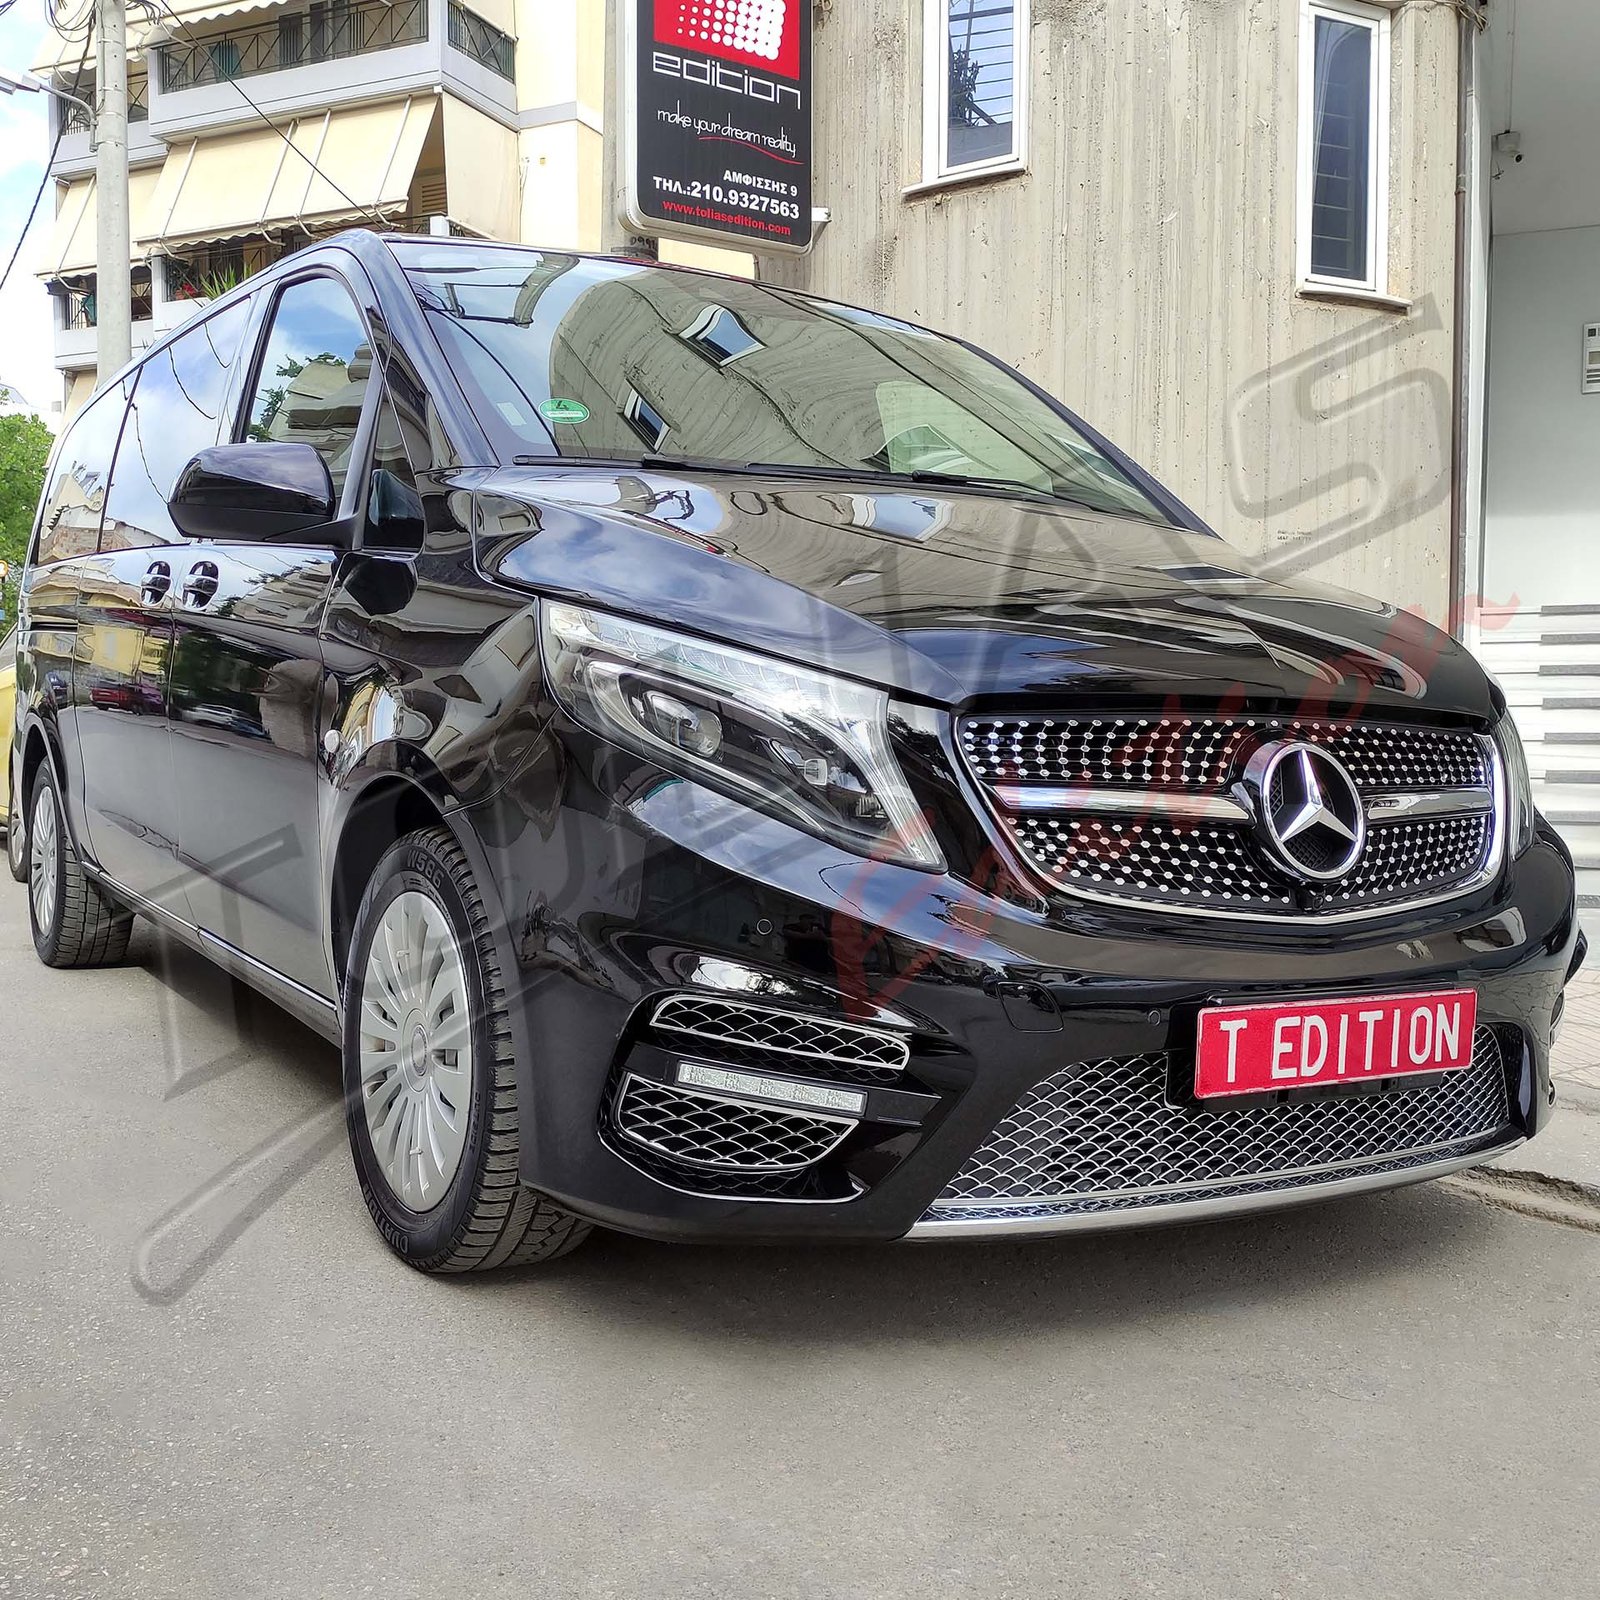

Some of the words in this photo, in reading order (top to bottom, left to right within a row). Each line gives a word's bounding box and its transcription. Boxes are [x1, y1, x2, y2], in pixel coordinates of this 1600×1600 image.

[652, 51, 801, 110] edition
[657, 99, 692, 128] make
[693, 117, 721, 135] your
[721, 112, 761, 144] dream
[762, 126, 796, 158] reality
[723, 169, 788, 195] ΑΜΦΙΣΣΗΣ
[790, 185, 798, 198] 9
[662, 200, 791, 236] www.toliasedition.com
[1219, 1018, 1248, 1083] T
[1271, 1002, 1461, 1080] EDITION
